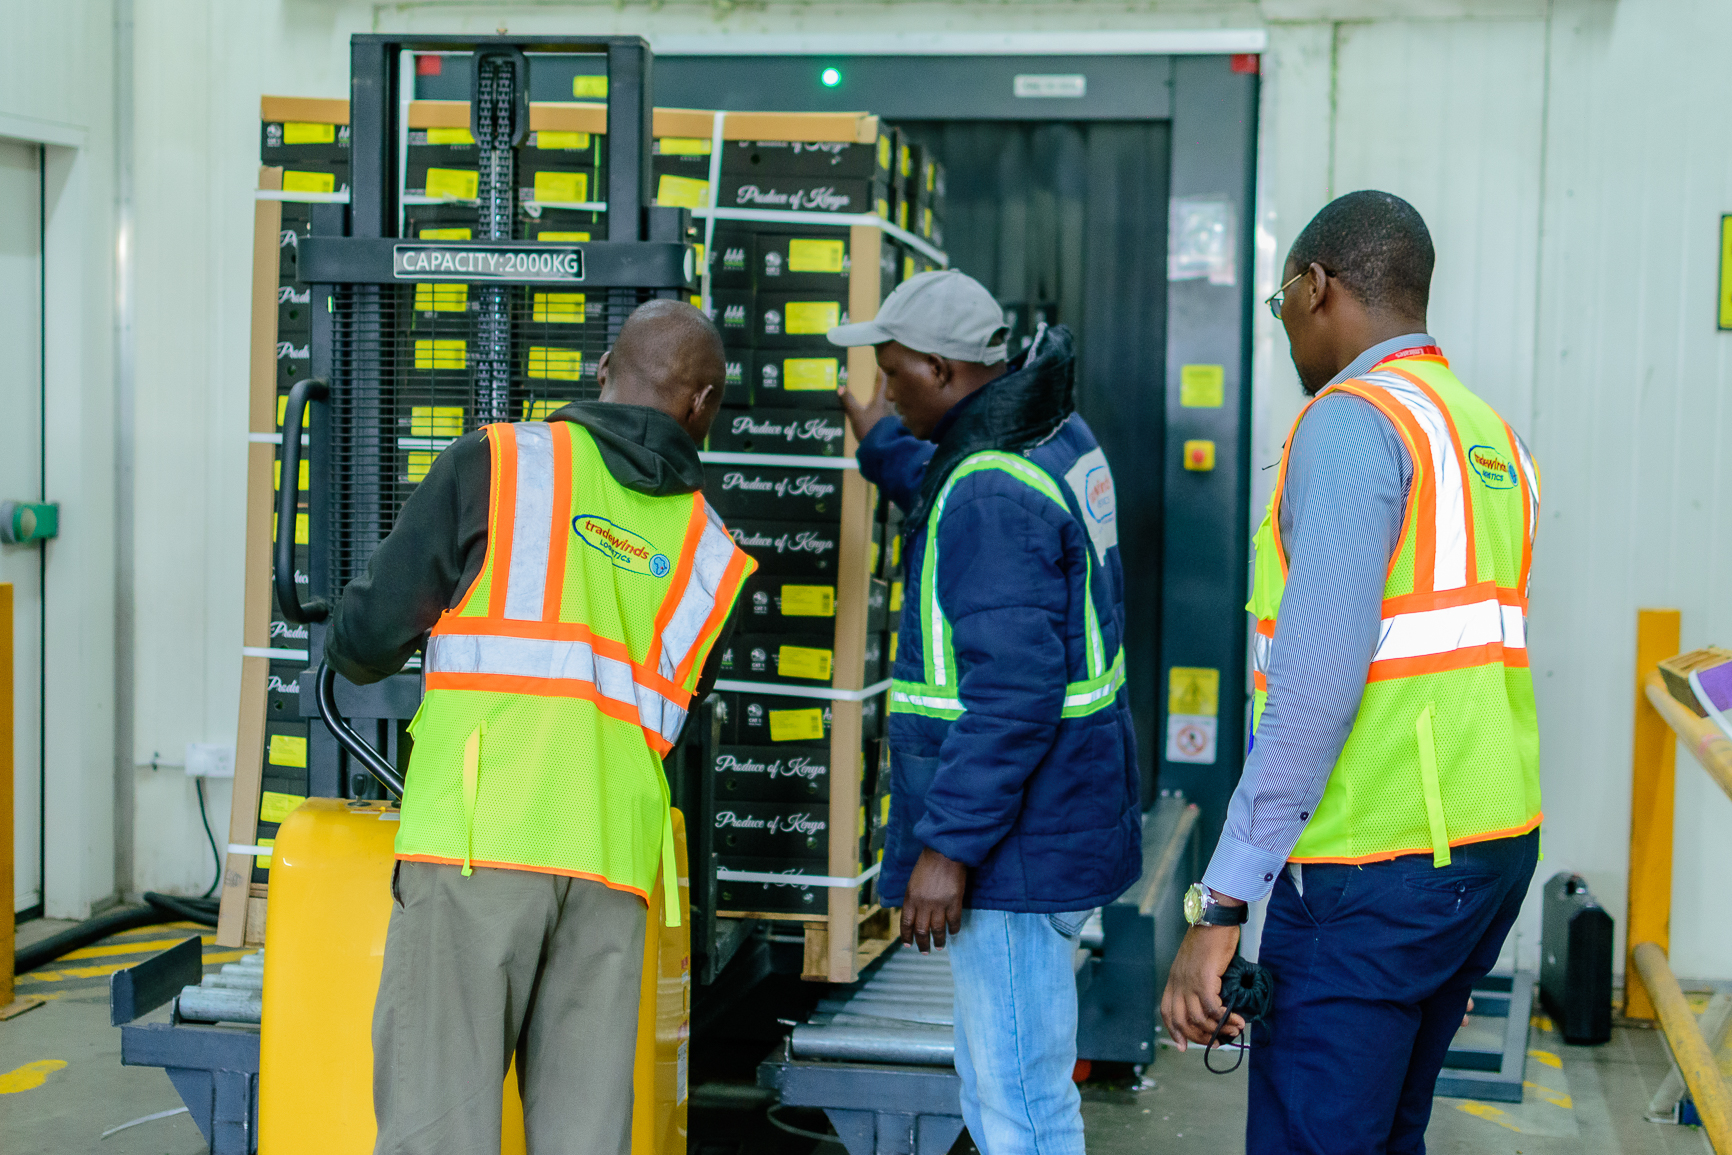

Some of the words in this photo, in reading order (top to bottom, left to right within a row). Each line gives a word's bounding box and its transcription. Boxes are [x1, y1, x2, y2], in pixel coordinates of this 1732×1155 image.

[402, 251, 579, 273] CAPACITY:2000KG
[731, 416, 782, 434] Produce
[783, 421, 798, 441] of
[797, 419, 843, 441] Kenya
[722, 472, 773, 490] Produce
[774, 478, 788, 497] of
[788, 476, 835, 498] Kenya
[585, 520, 649, 560] tradewinds
[600, 539, 631, 564] LOTICS
[728, 528, 773, 546] Produce
[774, 533, 788, 553] of
[788, 532, 834, 554] Kenya
[268, 675, 300, 693] Produ
[715, 755, 765, 772] Produce
[766, 759, 780, 779] of
[780, 757, 826, 779] Kenya
[715, 811, 765, 828] Produce
[766, 815, 780, 835] of
[780, 812, 826, 835] Kenya
